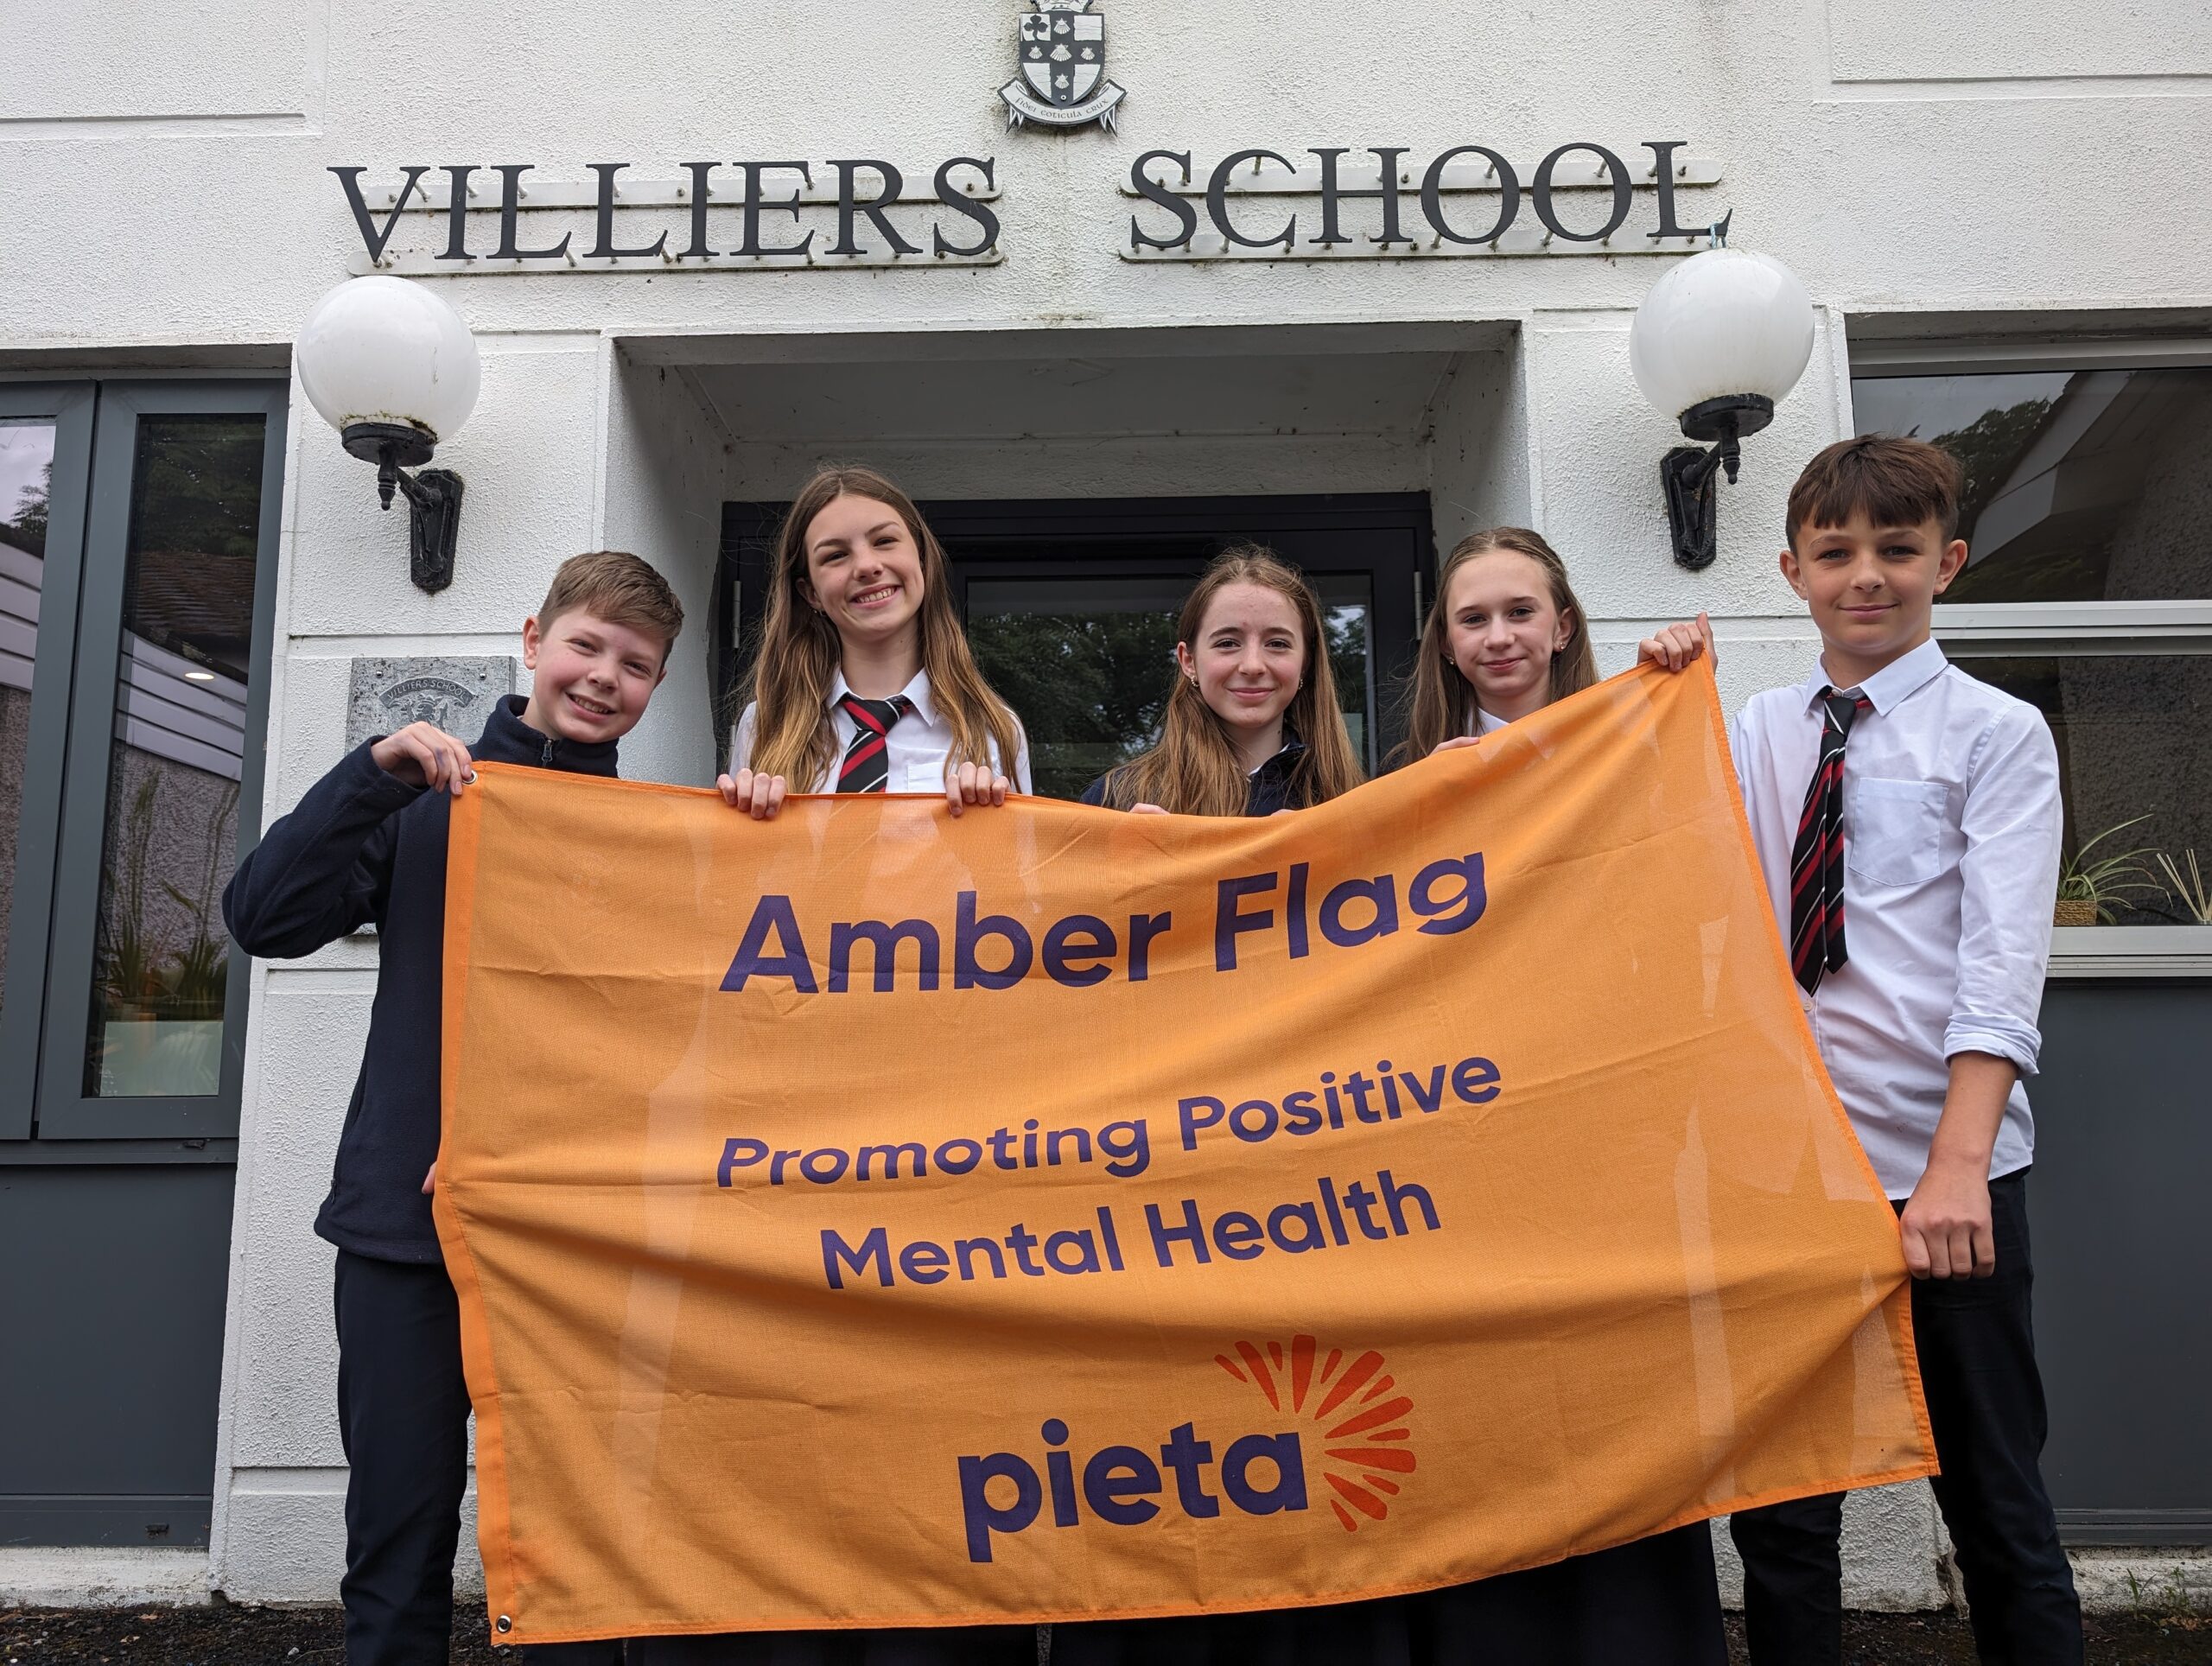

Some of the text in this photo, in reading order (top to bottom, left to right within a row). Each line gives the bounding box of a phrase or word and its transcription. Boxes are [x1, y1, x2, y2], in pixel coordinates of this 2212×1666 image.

[327, 141, 1733, 263] VILLIERS SCHOOL
[387, 679, 466, 700] VILLIERS SCHOOL
[718, 851, 1486, 994] Amber Flag
[715, 1055, 1503, 1188] Promoting Positive
[819, 1169, 1442, 1290] Mental Health
[957, 1418, 1308, 1563] pieta
